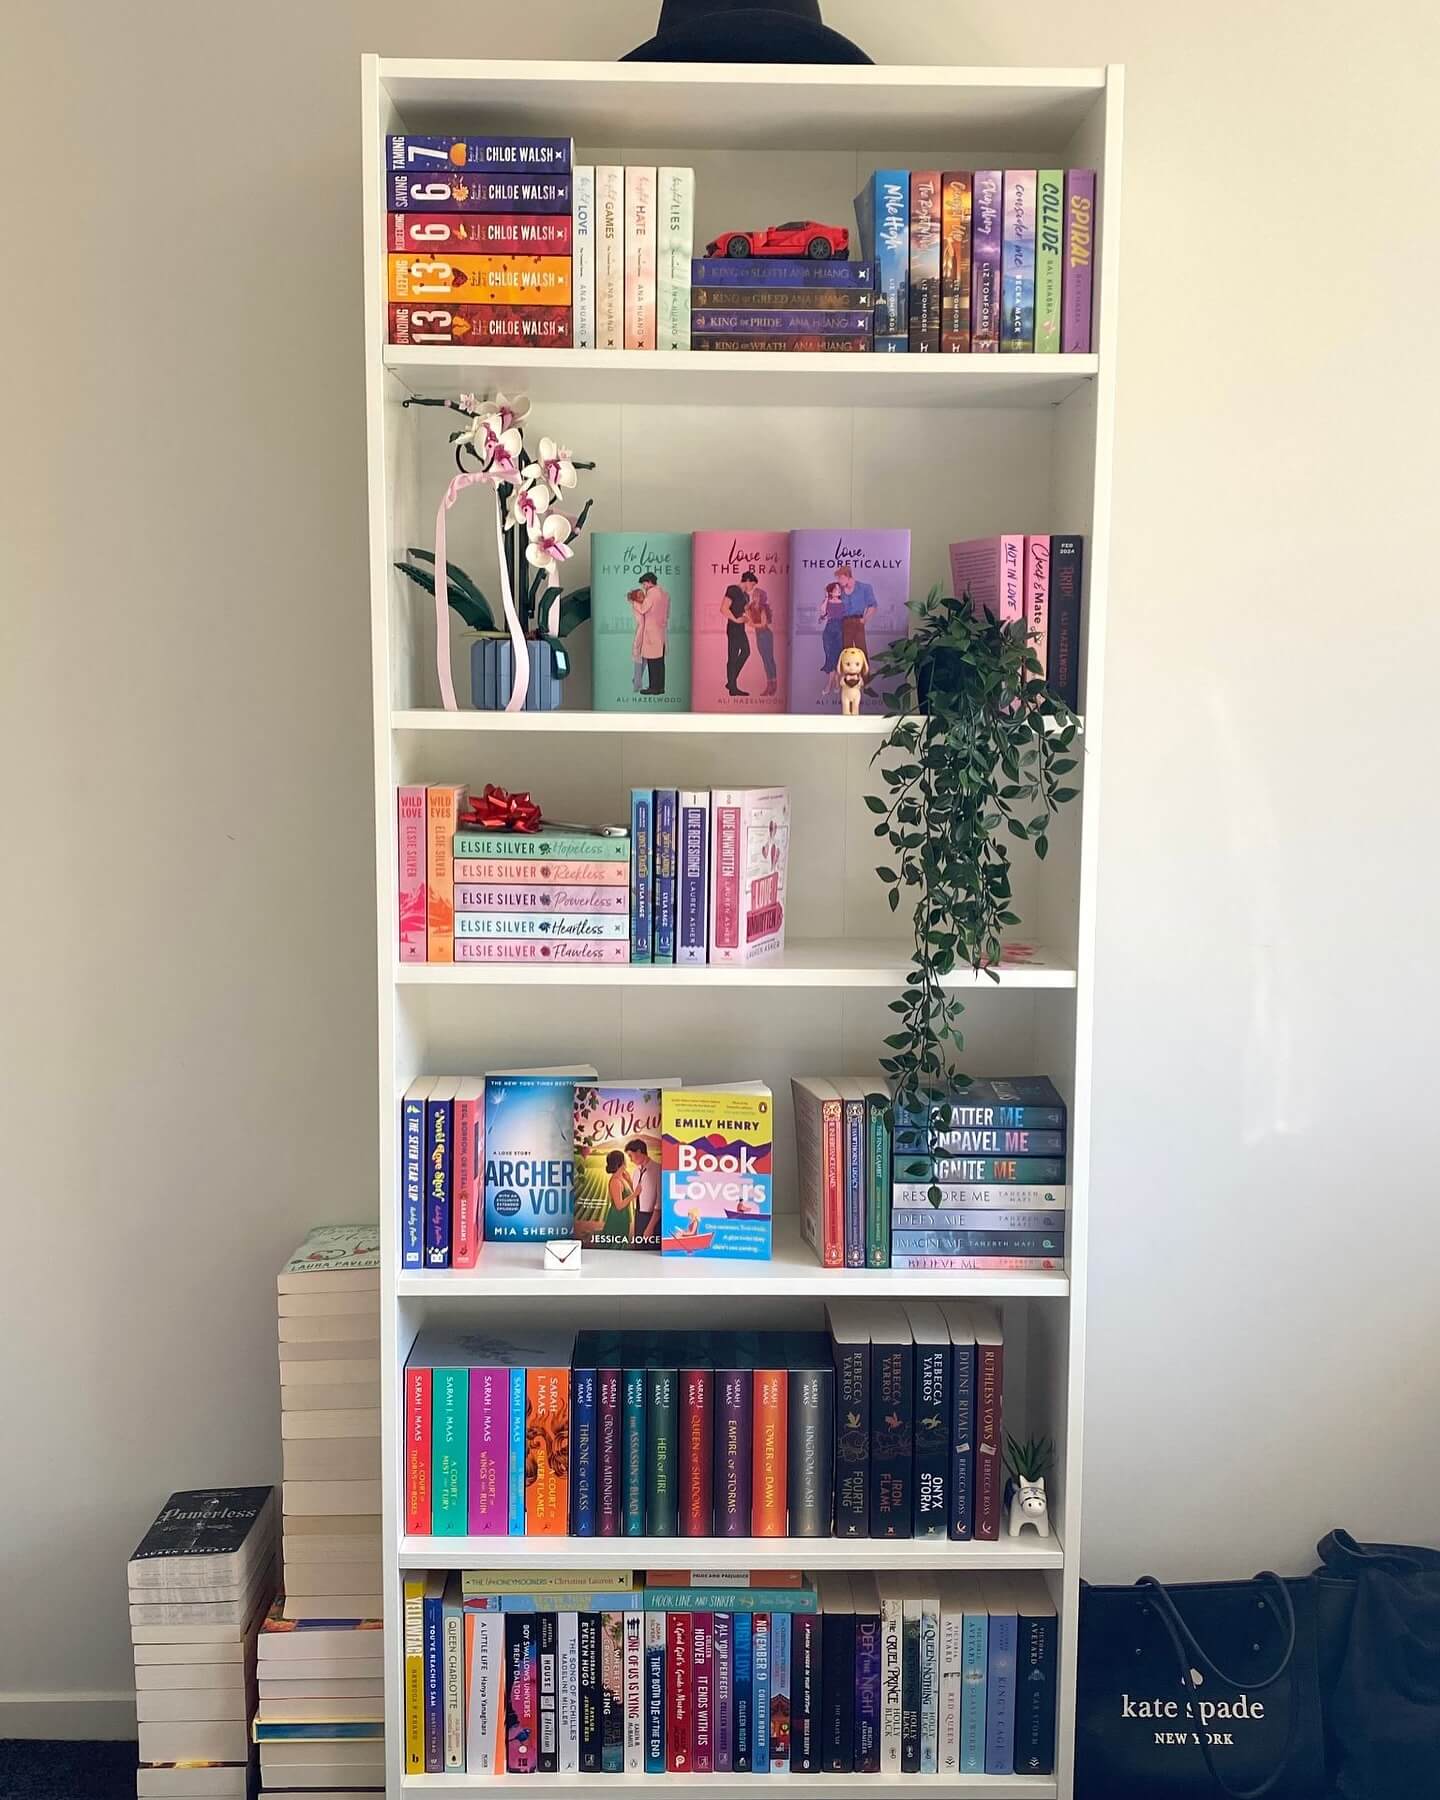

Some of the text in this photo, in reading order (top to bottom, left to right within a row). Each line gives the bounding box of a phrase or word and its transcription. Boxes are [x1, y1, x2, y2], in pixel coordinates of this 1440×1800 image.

[393, 137, 448, 169] TAMING 7
[486, 148, 553, 162] CHLOE WALSH
[396, 176, 451, 207] SAVING 6
[489, 185, 555, 199] CHLOE WALSH
[578, 205, 587, 235] LOVE
[605, 202, 614, 239] GAMES
[636, 205, 646, 235] HATE
[670, 204, 680, 231] LIES
[1042, 182, 1059, 255] COLLIDE
[488, 226, 554, 240] CHLOE WALSH
[1070, 196, 1091, 268] SPIRAL
[488, 273, 555, 287] CHLOE WALSH
[982, 262, 990, 333] LIZ TOMFORDE
[397, 309, 452, 344] BINDING 13
[489, 321, 556, 335] CHLOE WALSH
[710, 317, 737, 326] KING
[750, 318, 782, 327] PRIDE
[813, 318, 848, 327] HUANG
[715, 340, 738, 350] KING
[751, 340, 785, 350] WRATH
[817, 340, 852, 350] HUANG
[802, 559, 903, 569] THEORETICALLY
[401, 797, 422, 806] WILD
[401, 807, 423, 818] LOVE
[430, 796, 451, 806] WILD
[430, 807, 451, 818] EYES
[461, 919, 604, 935] ELSIE SILVER Heartless
[462, 944, 603, 959] ELSIE SILVER Flawless
[603, 1100, 635, 1116] The
[409, 1118, 420, 1131] THE
[593, 1120, 615, 1141] Ex
[675, 1119, 760, 1131] EMILY HENRY
[409, 1134, 419, 1160] SEVEN
[1005, 1132, 1029, 1151] ME
[678, 1144, 758, 1174] Book
[486, 1161, 574, 1187] ARCHER
[408, 1184, 419, 1201] SLIP
[669, 1172, 766, 1204] Lovers
[902, 1191, 990, 1201] RESORE ME
[590, 1234, 660, 1244] JESSICA JOYCE
[843, 1357, 851, 1401] YARROS
[853, 1352, 862, 1405] REBECCA
[882, 1358, 891, 1401] YARROS
[892, 1353, 901, 1405] REBECCA
[923, 1357, 932, 1402] YARROS
[933, 1353, 943, 1406] REBECCA
[550, 1377, 558, 1413] SARAH
[959, 1352, 969, 1441] DIVINE RIVALS
[983, 1351, 995, 1441] RUTHLESS VOWS
[580, 1424, 589, 1465] THRONE
[604, 1415, 614, 1452] CROWN
[658, 1438, 666, 1462] HEIR
[580, 1479, 588, 1510] GLASS
[603, 1465, 612, 1515] MIDNIGHT
[657, 1474, 666, 1494] FIRE
[842, 1478, 852, 1507] WING
[853, 1471, 864, 1513] FOURTH
[880, 1474, 891, 1513] FLAME
[893, 1480, 902, 1506] IRON
[920, 1473, 931, 1512] STORM
[932, 1477, 944, 1508] ONYX
[480, 1492, 488, 1514] RUIN
[480, 1630, 488, 1655] LITTLE
[694, 1628, 704, 1664] HOOVER
[756, 1620, 767, 1680] NOVEMBER 9
[886, 1635, 897, 1666] CRUEL
[448, 1622, 457, 1709] QUEEN CHARLOTTE
[480, 1656, 488, 1671] LIFE
[651, 1657, 660, 1678] THEY
[922, 1630, 936, 1705] QUEEN NOTHING
[570, 1685, 576, 1696] OF
[651, 1680, 660, 1698] BOTH
[698, 1685, 708, 1708] ENDS
[883, 1667, 900, 1704] PRINCE
[603, 1692, 611, 1715] SING
[651, 1700, 660, 1715] DIE
[1121, 1694, 1178, 1718] kate
[480, 1698, 488, 1736] Yanagihara
[698, 1710, 708, 1734] WITH
[903, 1711, 911, 1740] BLACK
[946, 1714, 954, 1744] QUEEN
[651, 1740, 660, 1757] END
[698, 1734, 708, 1746] US
[1154, 1733, 1187, 1744] NEW
